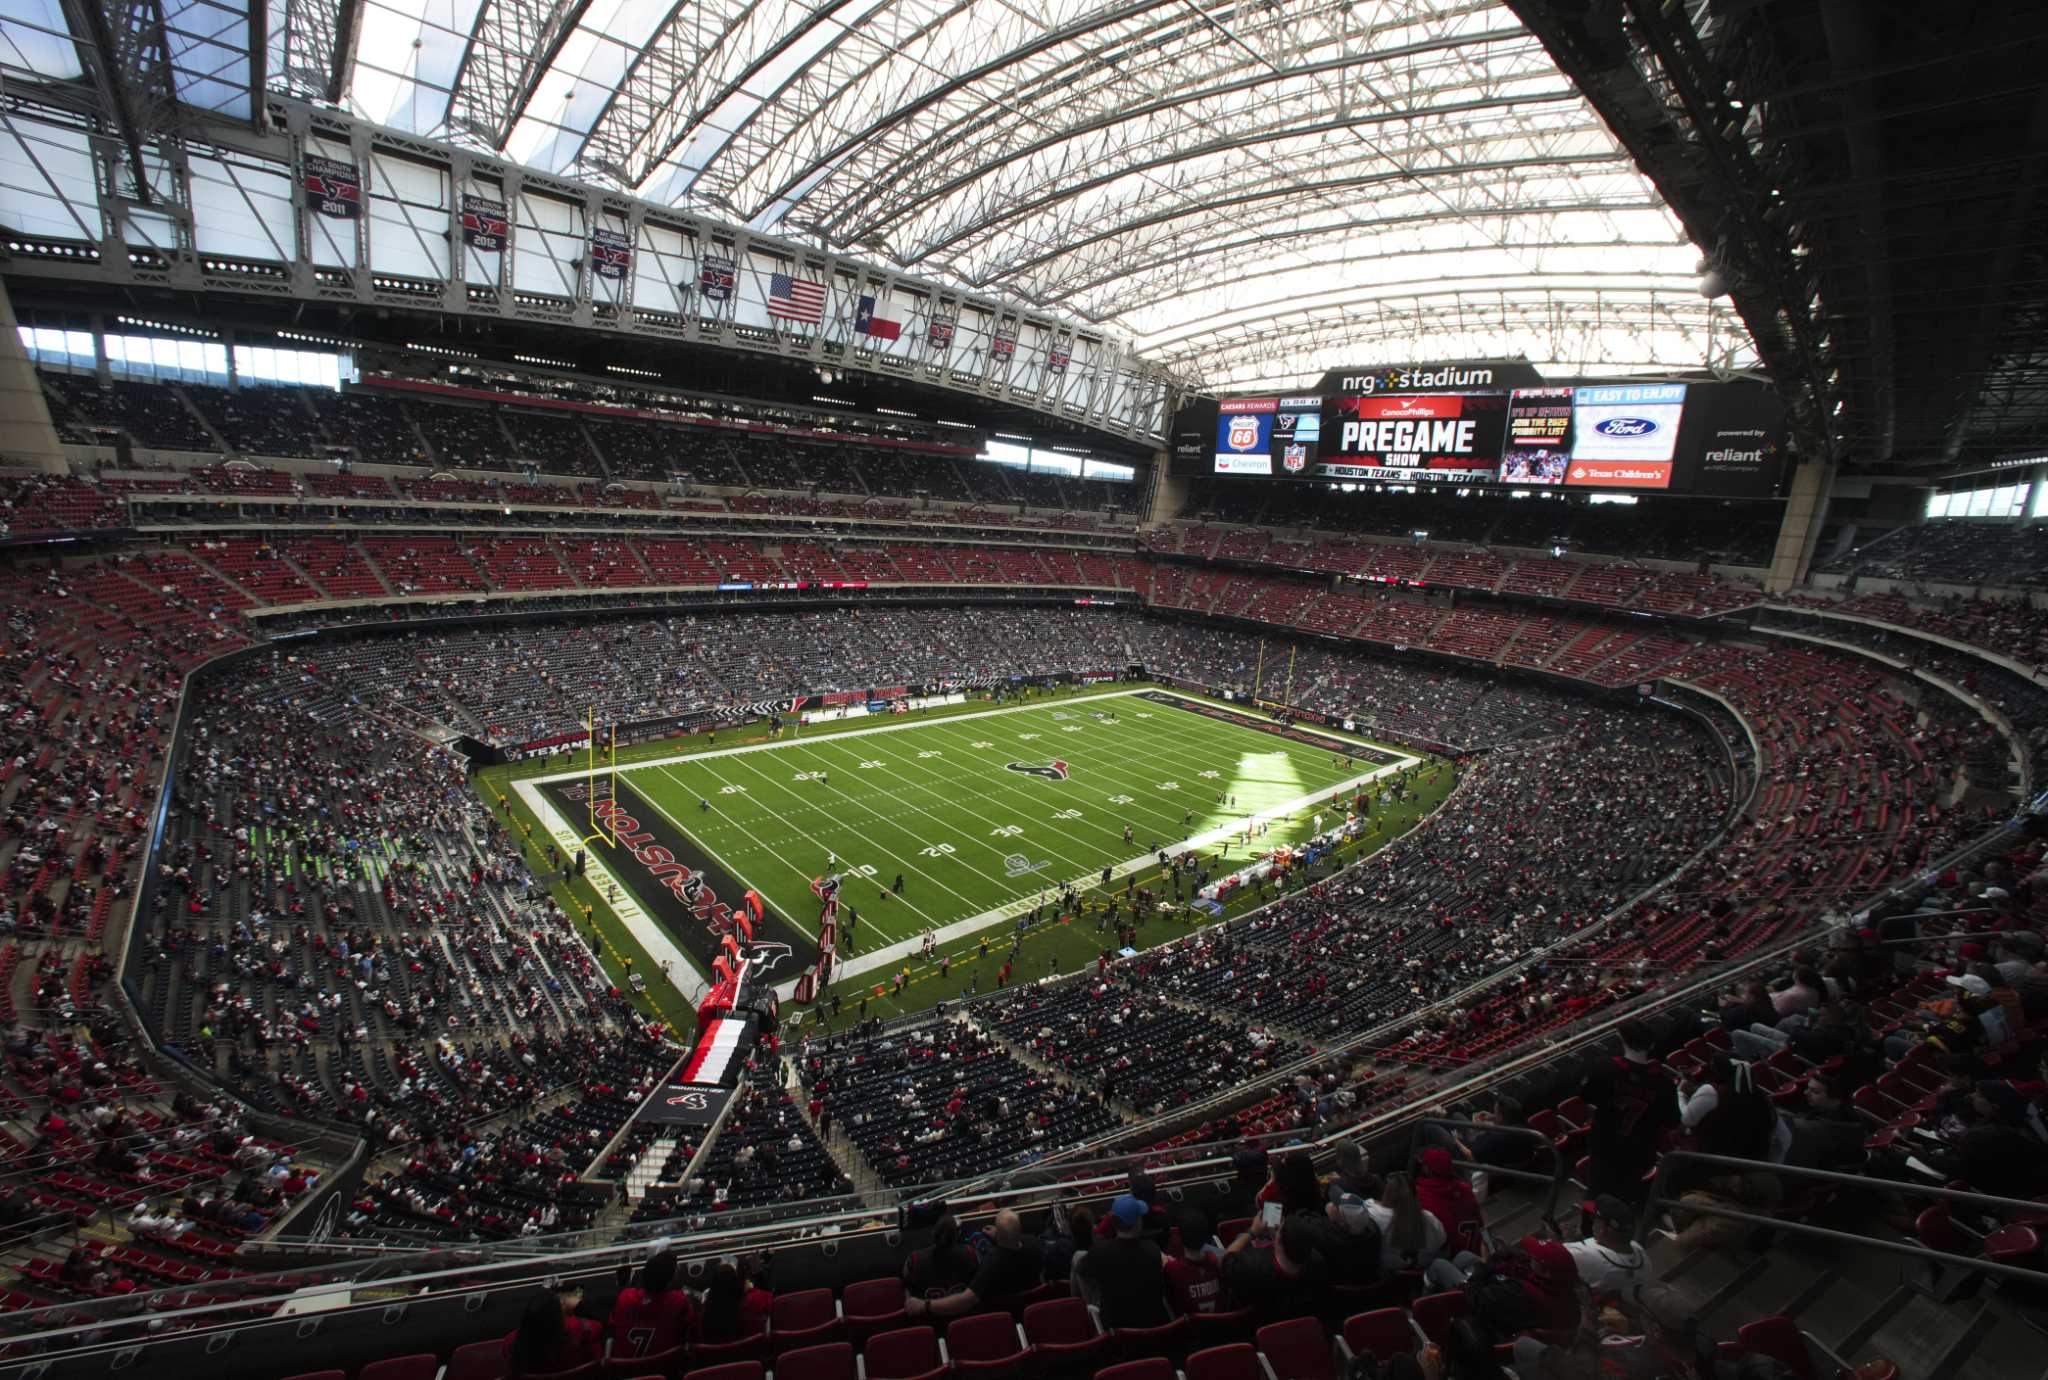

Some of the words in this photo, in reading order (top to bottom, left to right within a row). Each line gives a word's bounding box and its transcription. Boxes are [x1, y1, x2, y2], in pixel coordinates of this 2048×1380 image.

[307, 163, 358, 181] CHAMPIONS
[322, 200, 346, 215] 2011
[464, 202, 506, 217] CHAMPIONS
[473, 234, 497, 248] 2012
[1343, 375, 1375, 394] nrg
[1398, 367, 1492, 389] stadium
[1594, 390, 1623, 402] EASY
[1626, 389, 1641, 401] TO
[1643, 387, 1682, 400] ENJOY
[1381, 408, 1435, 417] ConocoPhillips
[1547, 427, 1567, 436] LIST
[1604, 419, 1647, 434] Ford
[1233, 431, 1252, 443] 66
[1341, 420, 1476, 452] PREGAME
[1717, 430, 1753, 438] powered
[1754, 430, 1766, 438] by
[1177, 444, 1201, 453] reliant
[1705, 448, 1762, 462] reliant
[1233, 459, 1268, 468] Chevron
[1385, 453, 1421, 466] SHOW
[1335, 467, 1369, 477] HOUSTON
[1371, 468, 1401, 479] TEXANS
[1410, 470, 1448, 481] HOUSTON
[1588, 469, 1614, 478] Texas
[527, 739, 591, 758] TEXANS
[1055, 809, 1083, 819] 40
[993, 824, 1025, 838] 30
[921, 843, 956, 857] 20
[848, 864, 878, 878] 10
[627, 1327, 657, 1359] 7
